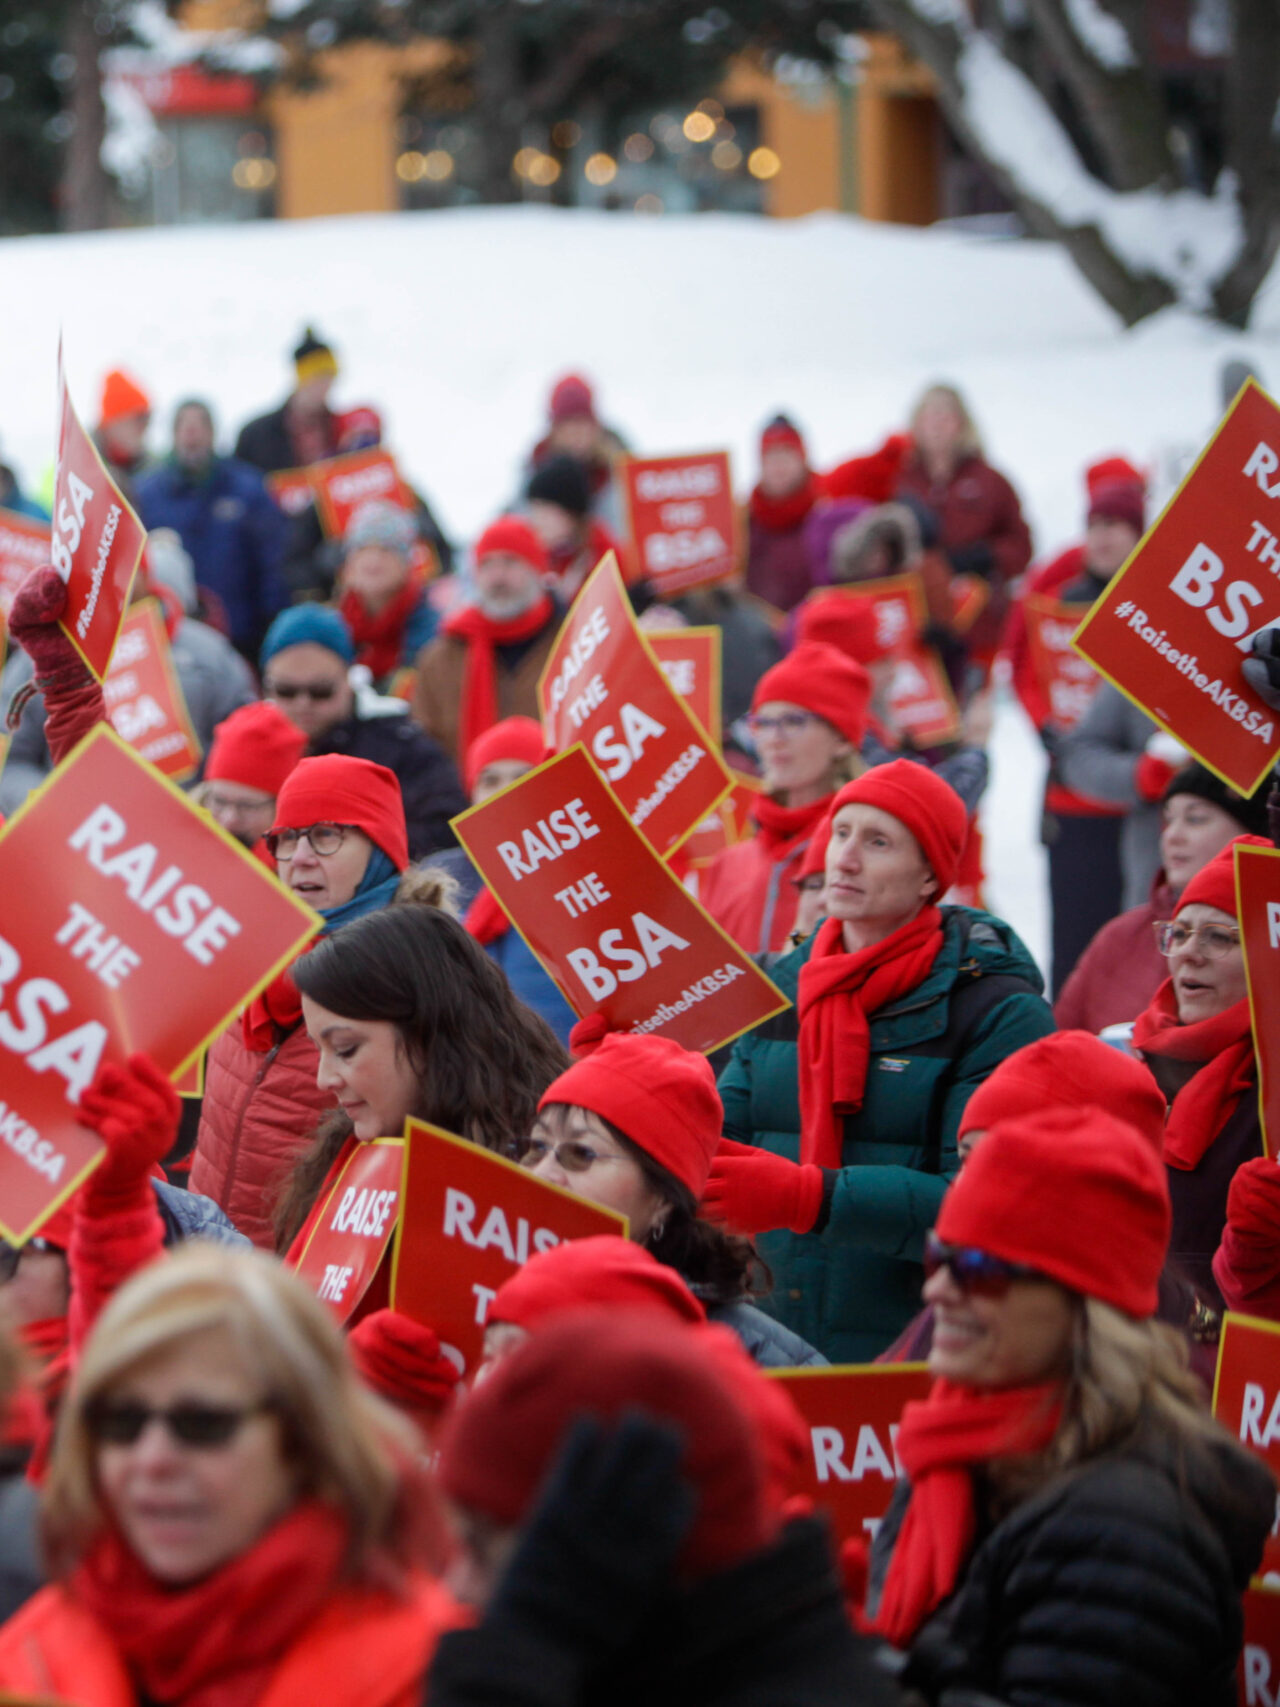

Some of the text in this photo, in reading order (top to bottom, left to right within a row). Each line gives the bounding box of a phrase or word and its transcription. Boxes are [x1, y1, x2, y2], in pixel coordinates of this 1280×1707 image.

[635, 464, 720, 502] RAISE
[75, 503, 122, 639] #RaisetheAKBSA
[644, 529, 727, 572] BSA
[550, 606, 610, 714] RAISE
[567, 674, 609, 728] THE
[1114, 600, 1275, 745] #RaisetheAKBSA
[593, 702, 667, 786] SA
[496, 797, 601, 881] RAISE
[68, 804, 241, 965] RAISE
[554, 872, 611, 918] THE
[55, 903, 141, 989] THE
[566, 911, 691, 1002] BSA
[330, 1186, 398, 1238] RAISE
[442, 1187, 570, 1265] RAIS
[317, 1264, 353, 1303] THE
